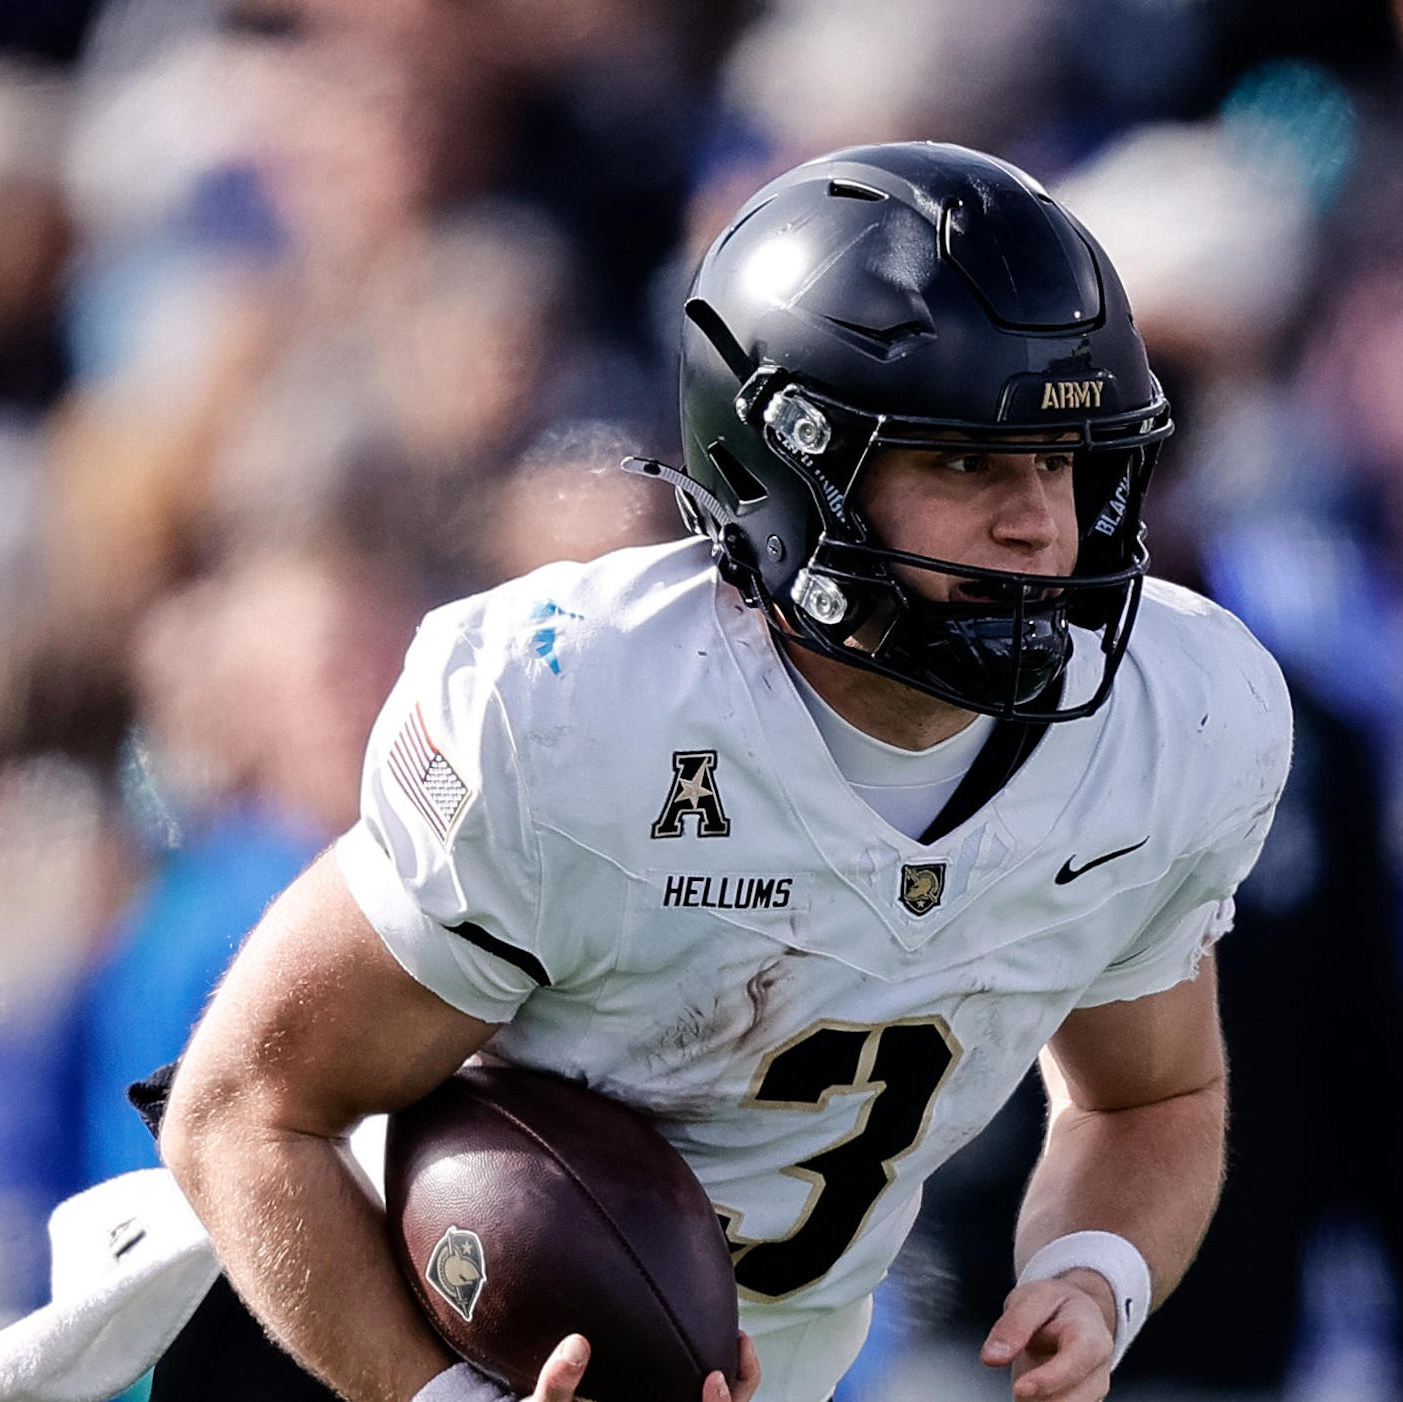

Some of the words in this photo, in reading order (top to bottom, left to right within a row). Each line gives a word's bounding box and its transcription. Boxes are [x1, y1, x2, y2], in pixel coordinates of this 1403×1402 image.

[1041, 381, 1103, 409] ARMY
[651, 749, 730, 839] A
[663, 876, 793, 909] HELLUMS
[710, 1014, 964, 1304] 3
